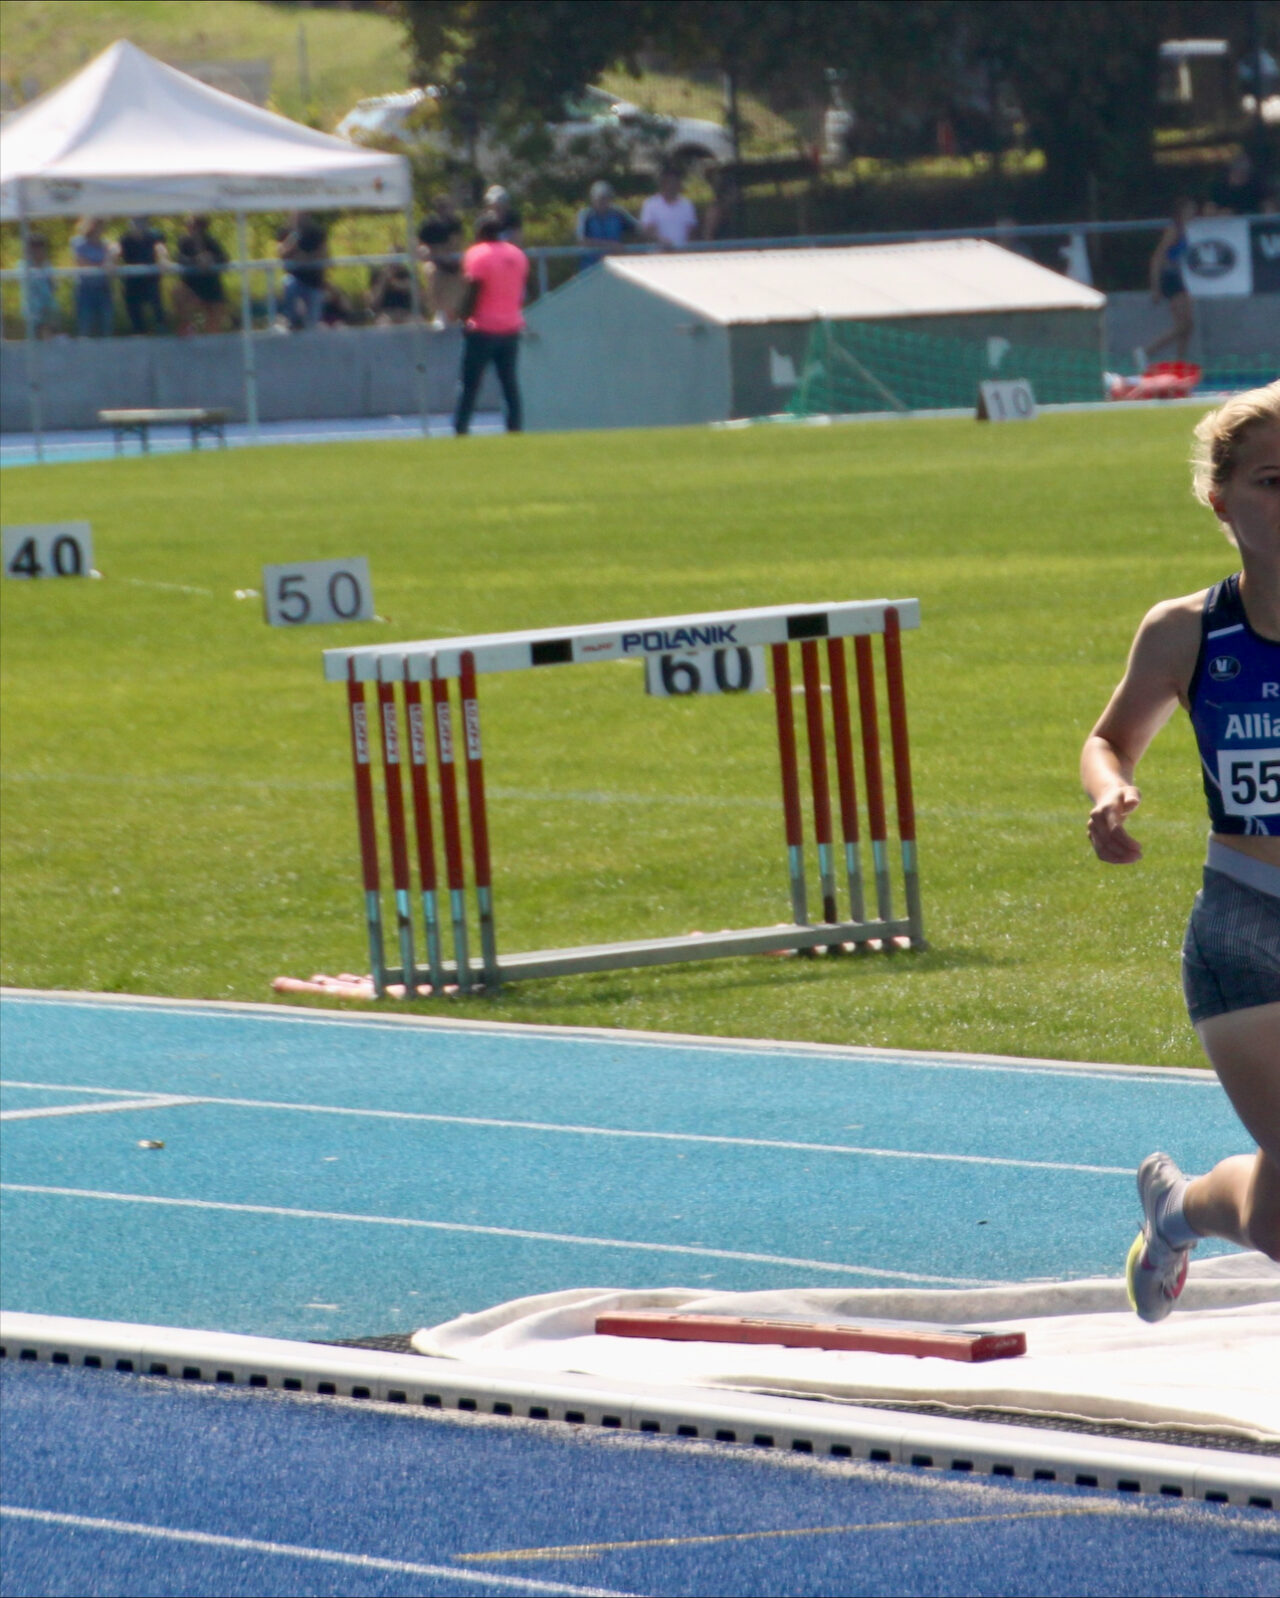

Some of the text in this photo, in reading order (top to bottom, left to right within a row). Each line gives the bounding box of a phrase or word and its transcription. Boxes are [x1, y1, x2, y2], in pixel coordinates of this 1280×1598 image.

[990, 387, 1032, 420] 10
[9, 534, 82, 578] 40
[278, 571, 362, 624] 50
[621, 624, 737, 653] POLANIK
[661, 646, 753, 695] 60
